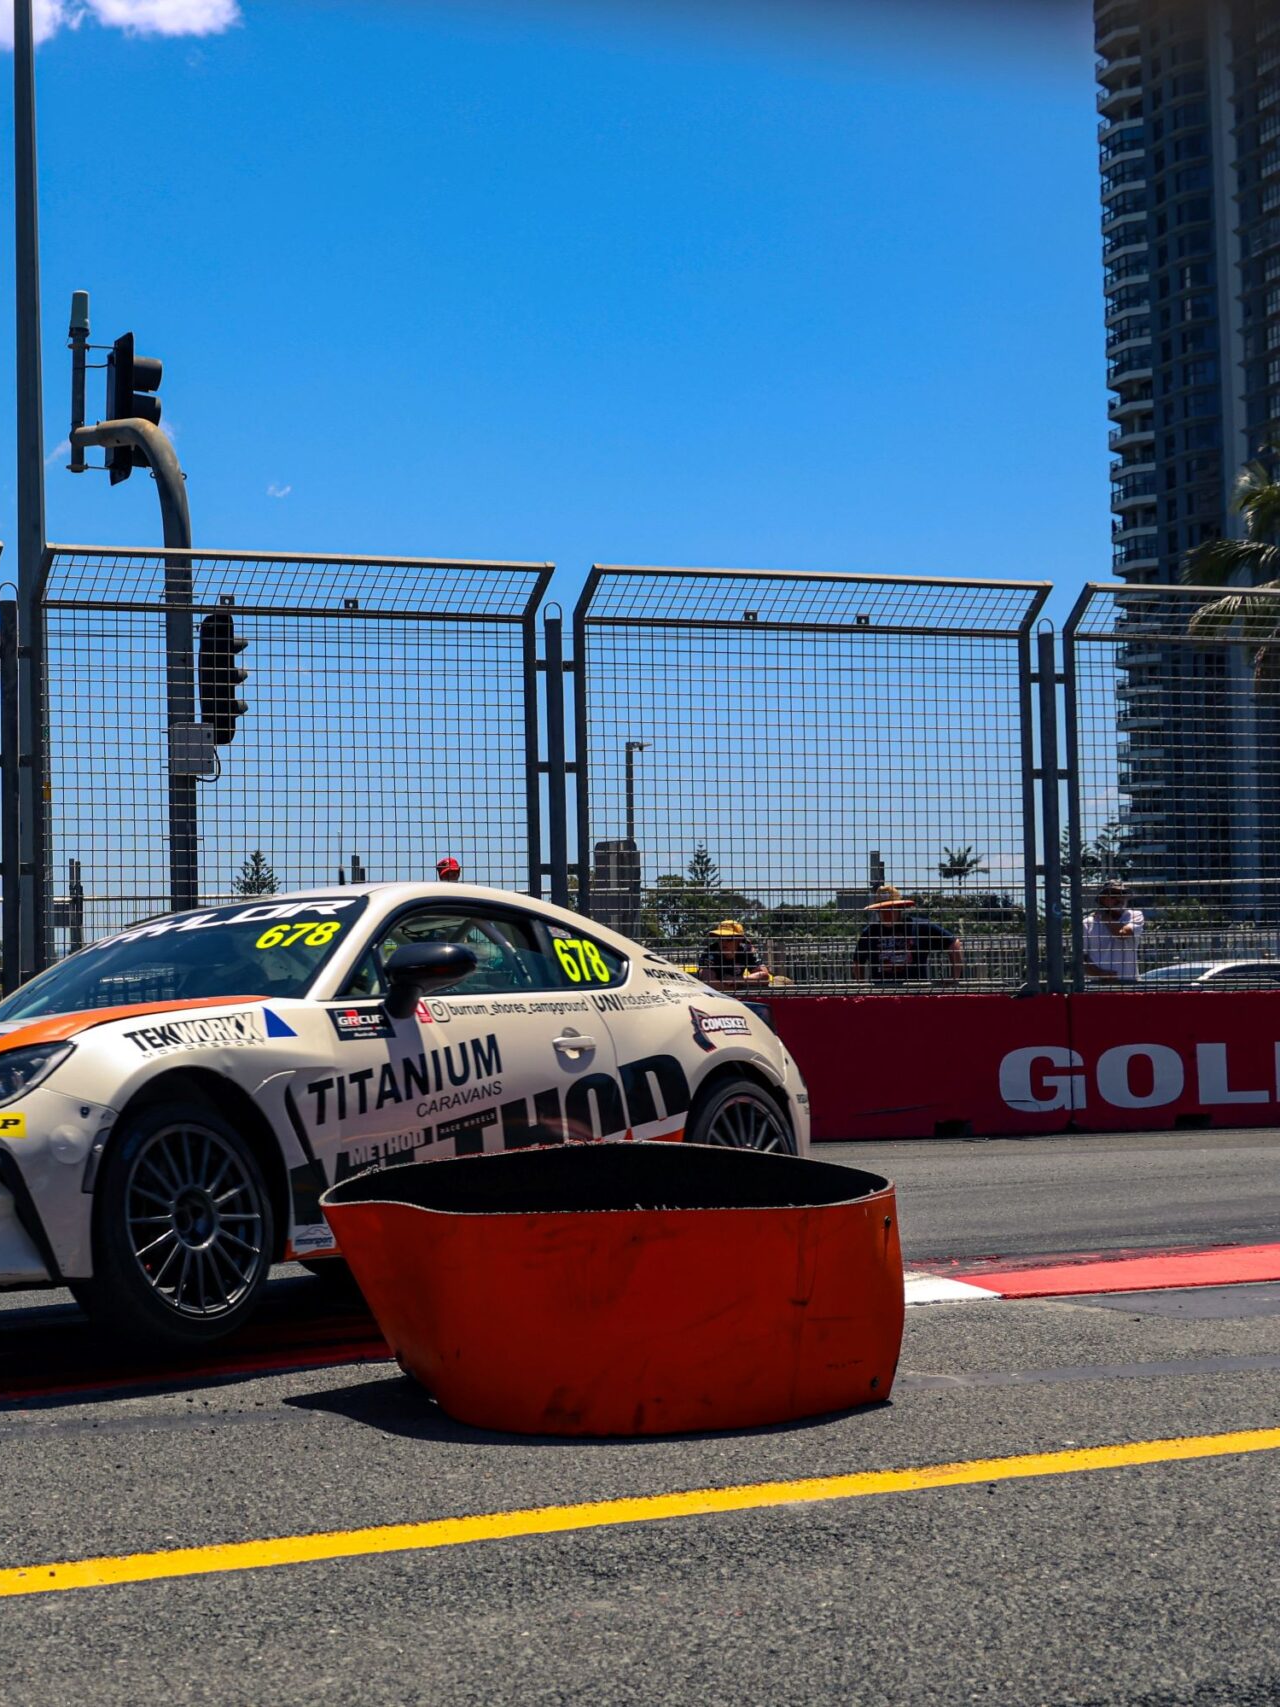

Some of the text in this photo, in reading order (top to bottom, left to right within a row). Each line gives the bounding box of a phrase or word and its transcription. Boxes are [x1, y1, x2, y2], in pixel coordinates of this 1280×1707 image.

[255, 921, 341, 949] 678
[553, 938, 610, 982] 678
[448, 998, 589, 1016] burrum_shores_campground
[590, 993, 625, 1012] UNI
[700, 1017, 747, 1032] COMISKEY
[142, 1040, 268, 1059] MOTORSPORT
[308, 1033, 503, 1126] TITANIUM
[999, 1042, 1280, 1113] GOL
[416, 1081, 503, 1119] CARAVANS
[439, 1112, 496, 1135] RACE WHEELS
[347, 1129, 426, 1167] METHOD
